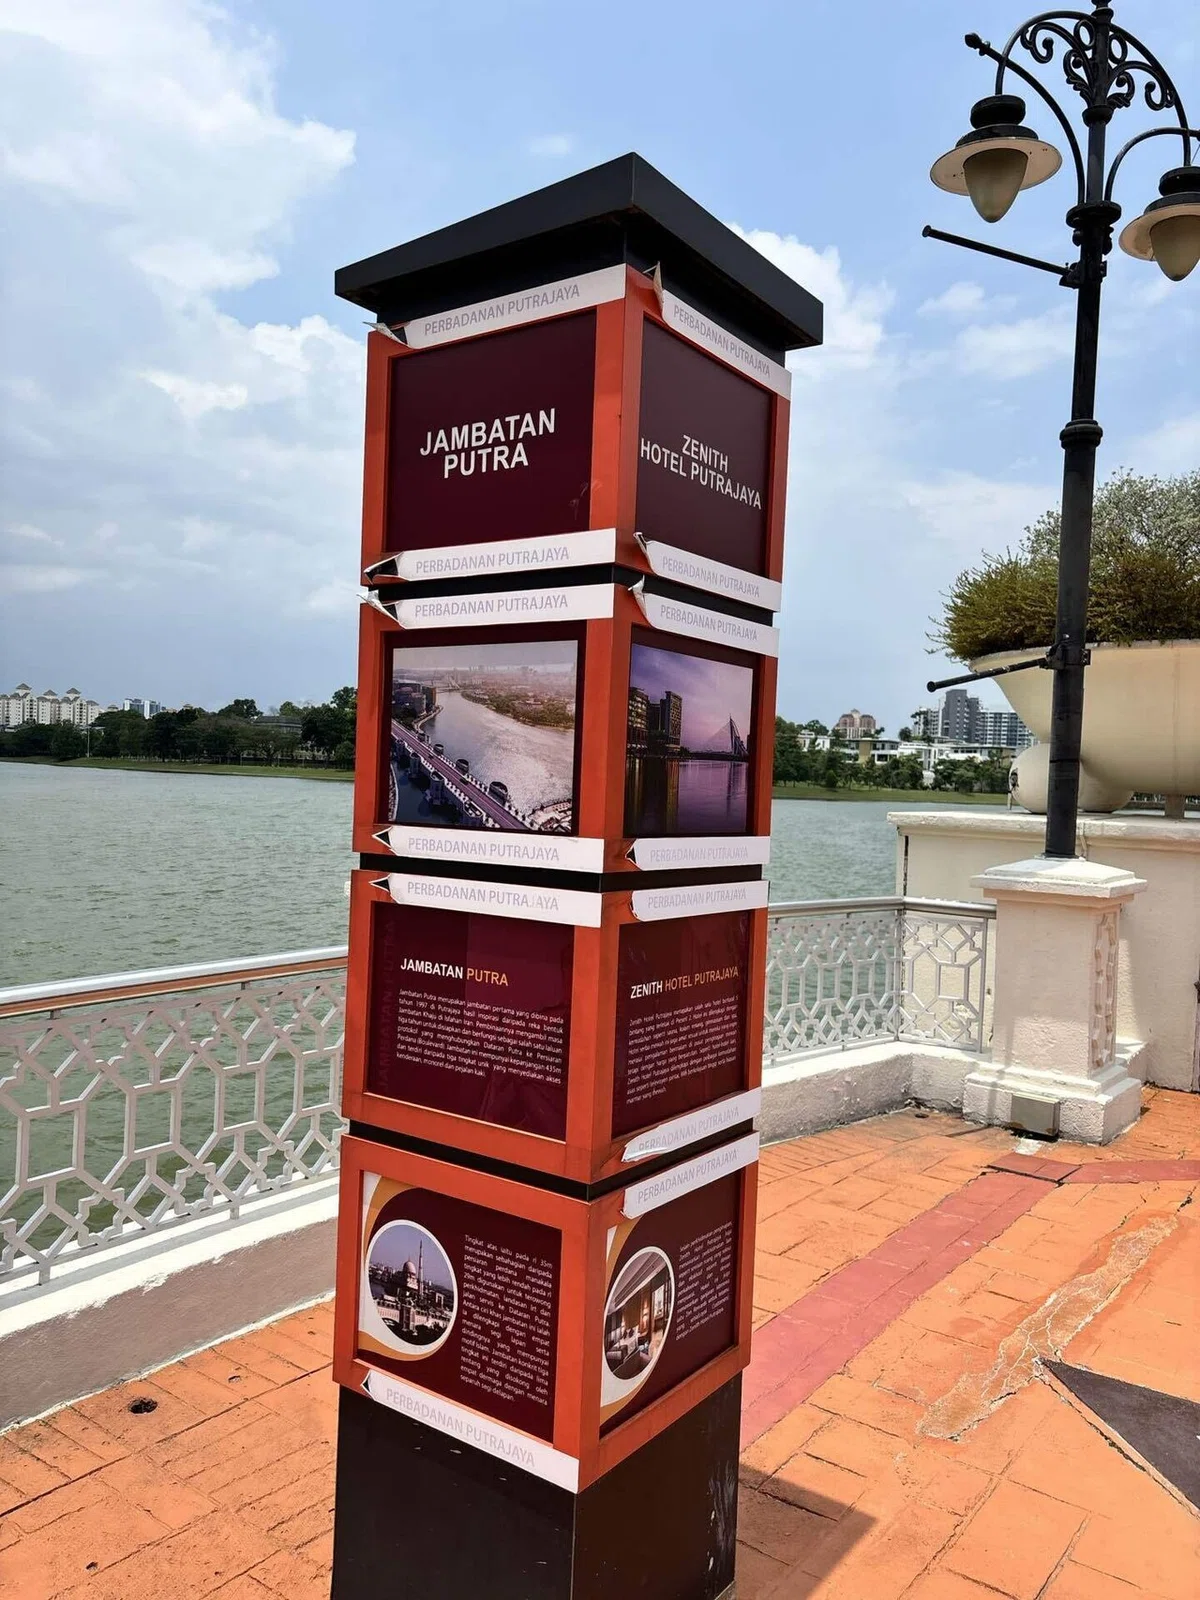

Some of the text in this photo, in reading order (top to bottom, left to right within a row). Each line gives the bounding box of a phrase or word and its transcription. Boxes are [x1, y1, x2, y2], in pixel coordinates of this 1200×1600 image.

[424, 284, 580, 335] PERBADANAN PUTRAJAYA
[673, 305, 770, 379] PERBADANAN PUTRAJAYA
[420, 408, 555, 456] JAMBATAN
[444, 442, 529, 479] PUTRA
[682, 434, 728, 473] ZENITH
[640, 437, 761, 510] HOTEL PUTRAJAYA
[416, 546, 569, 574] PERBADANAN PUTRAJAYA
[662, 556, 760, 598] PERBADANAN PUTRAJAYA
[414, 594, 568, 618] PERBADANAN PUTRAJAYA
[660, 604, 758, 641] PERBADANAN PUTRAJAYA
[408, 837, 560, 861] PERBADANAN PUTRAJAYA
[650, 846, 748, 863] PERBADANAN PUTRAJAYA
[407, 881, 486, 903] PERBADANAN
[647, 887, 747, 909] PERBADANAN PUTRAJAYA
[400, 958, 509, 987] JAMBATAN PUTRA
[630, 966, 739, 999] ZENITH HOTEL PUTRAJAYA
[699, 1106, 739, 1133] PUTRAJAYA
[637, 1148, 738, 1204] PERBADANAN PUTRAJAYA
[386, 1388, 535, 1467] PERBADANAN PUTRAJAYA
